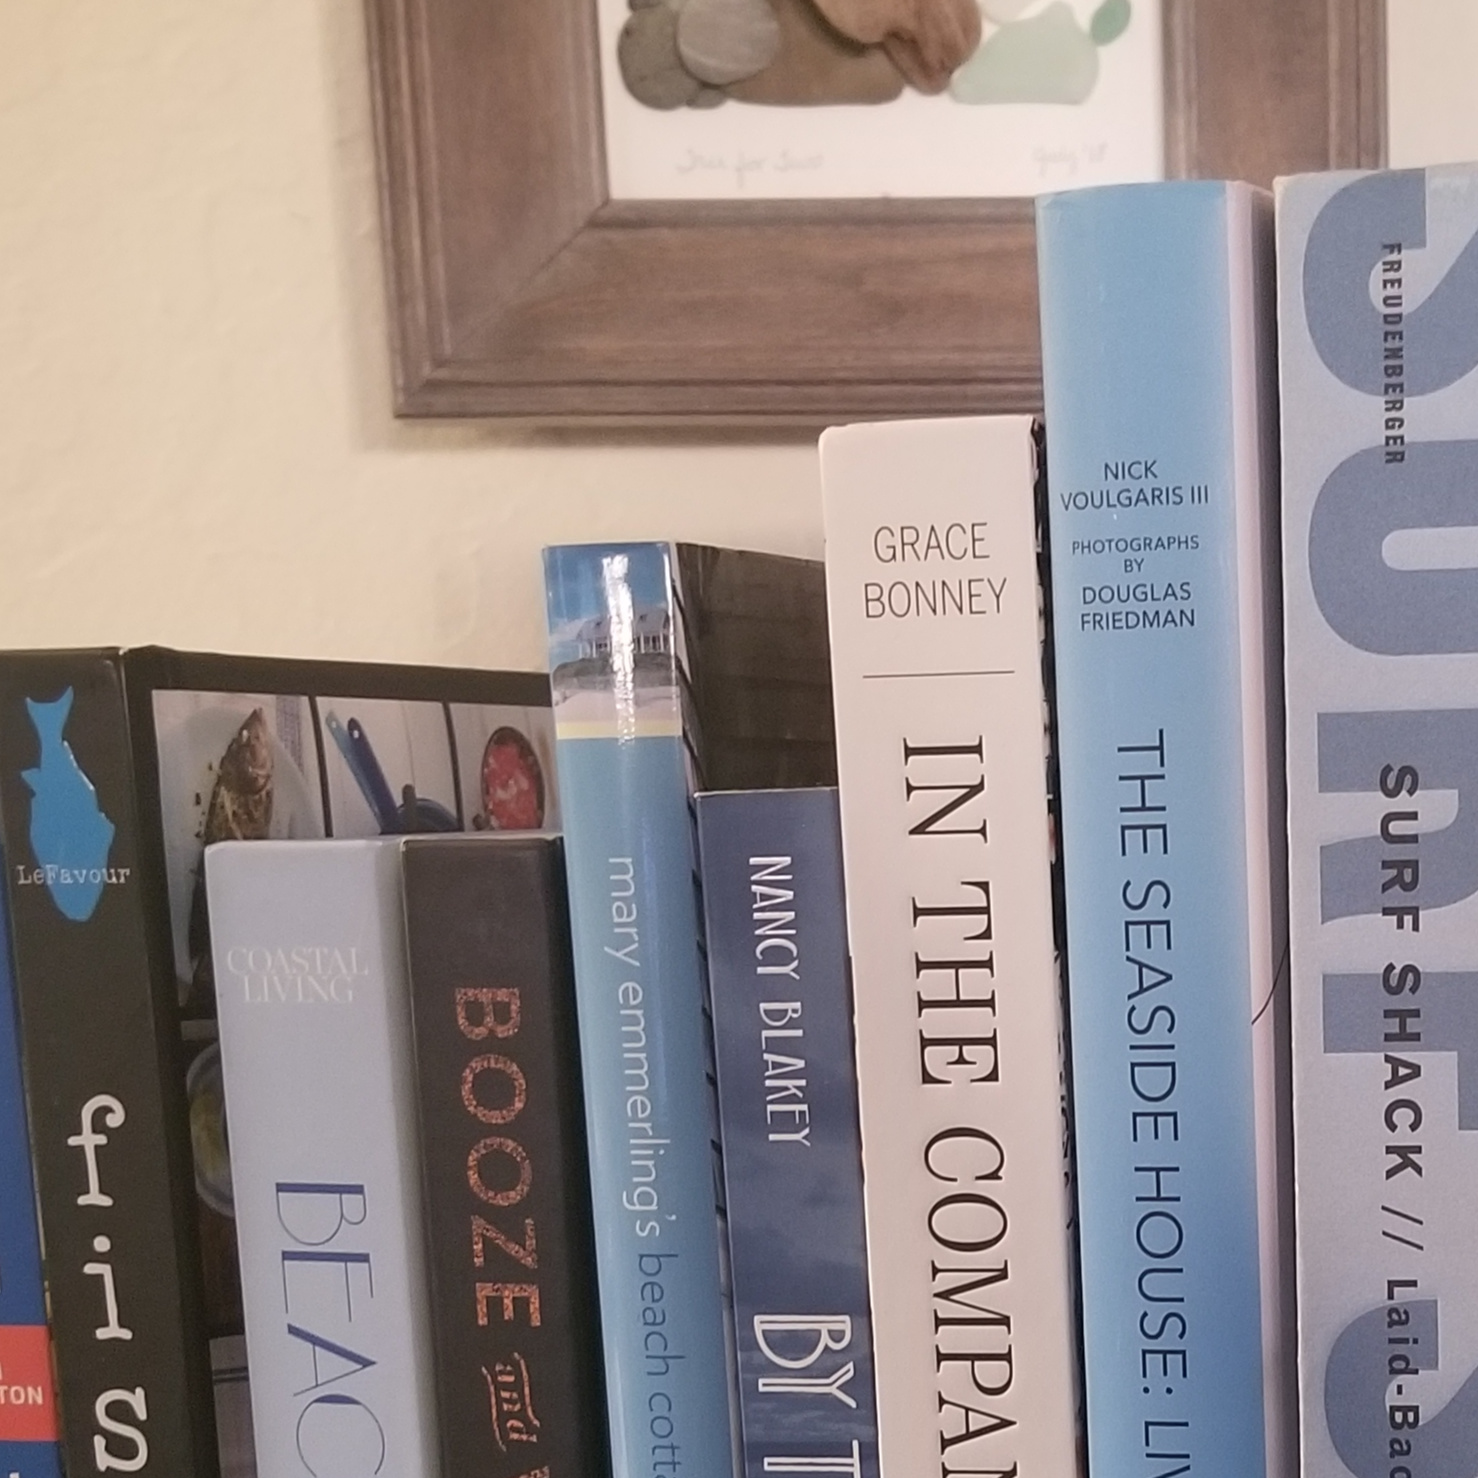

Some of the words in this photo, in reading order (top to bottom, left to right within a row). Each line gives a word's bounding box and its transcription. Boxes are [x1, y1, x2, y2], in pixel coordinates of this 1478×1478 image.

[1380, 242, 1406, 465] FREUDENBERGER
[1060, 487, 1184, 513] VOULGARIS
[1190, 484, 1210, 506] III
[1103, 460, 1159, 482] NICK
[863, 577, 1008, 619] BONNEY
[873, 522, 991, 564] GRACE
[1071, 534, 1200, 557] PHOTOGRAPHS
[1081, 582, 1192, 606] DOUGLAS
[1123, 558, 1146, 574] BY
[1080, 608, 1196, 632] FRIEDMAN
[902, 734, 989, 845] IN
[1117, 728, 1169, 857] THE
[17, 863, 131, 885] LeFavour
[1378, 762, 1421, 934] SURF
[226, 945, 369, 977] COASTAL
[605, 857, 642, 970] mary
[748, 855, 801, 981] NANCY
[242, 974, 353, 1003] LIVING
[911, 880, 1000, 1086] THE
[1121, 879, 1180, 1143] SEASIDE
[616, 979, 677, 1238] emmerling's
[758, 1000, 811, 1147] BLAKEY
[1382, 961, 1424, 1181] SHACK
[455, 988, 543, 1327] BOOZE
[637, 1252, 687, 1377] beach
[1133, 1166, 1188, 1396] HOUSE:
[488, 1356, 540, 1448] and
[753, 1314, 858, 1409] BY
